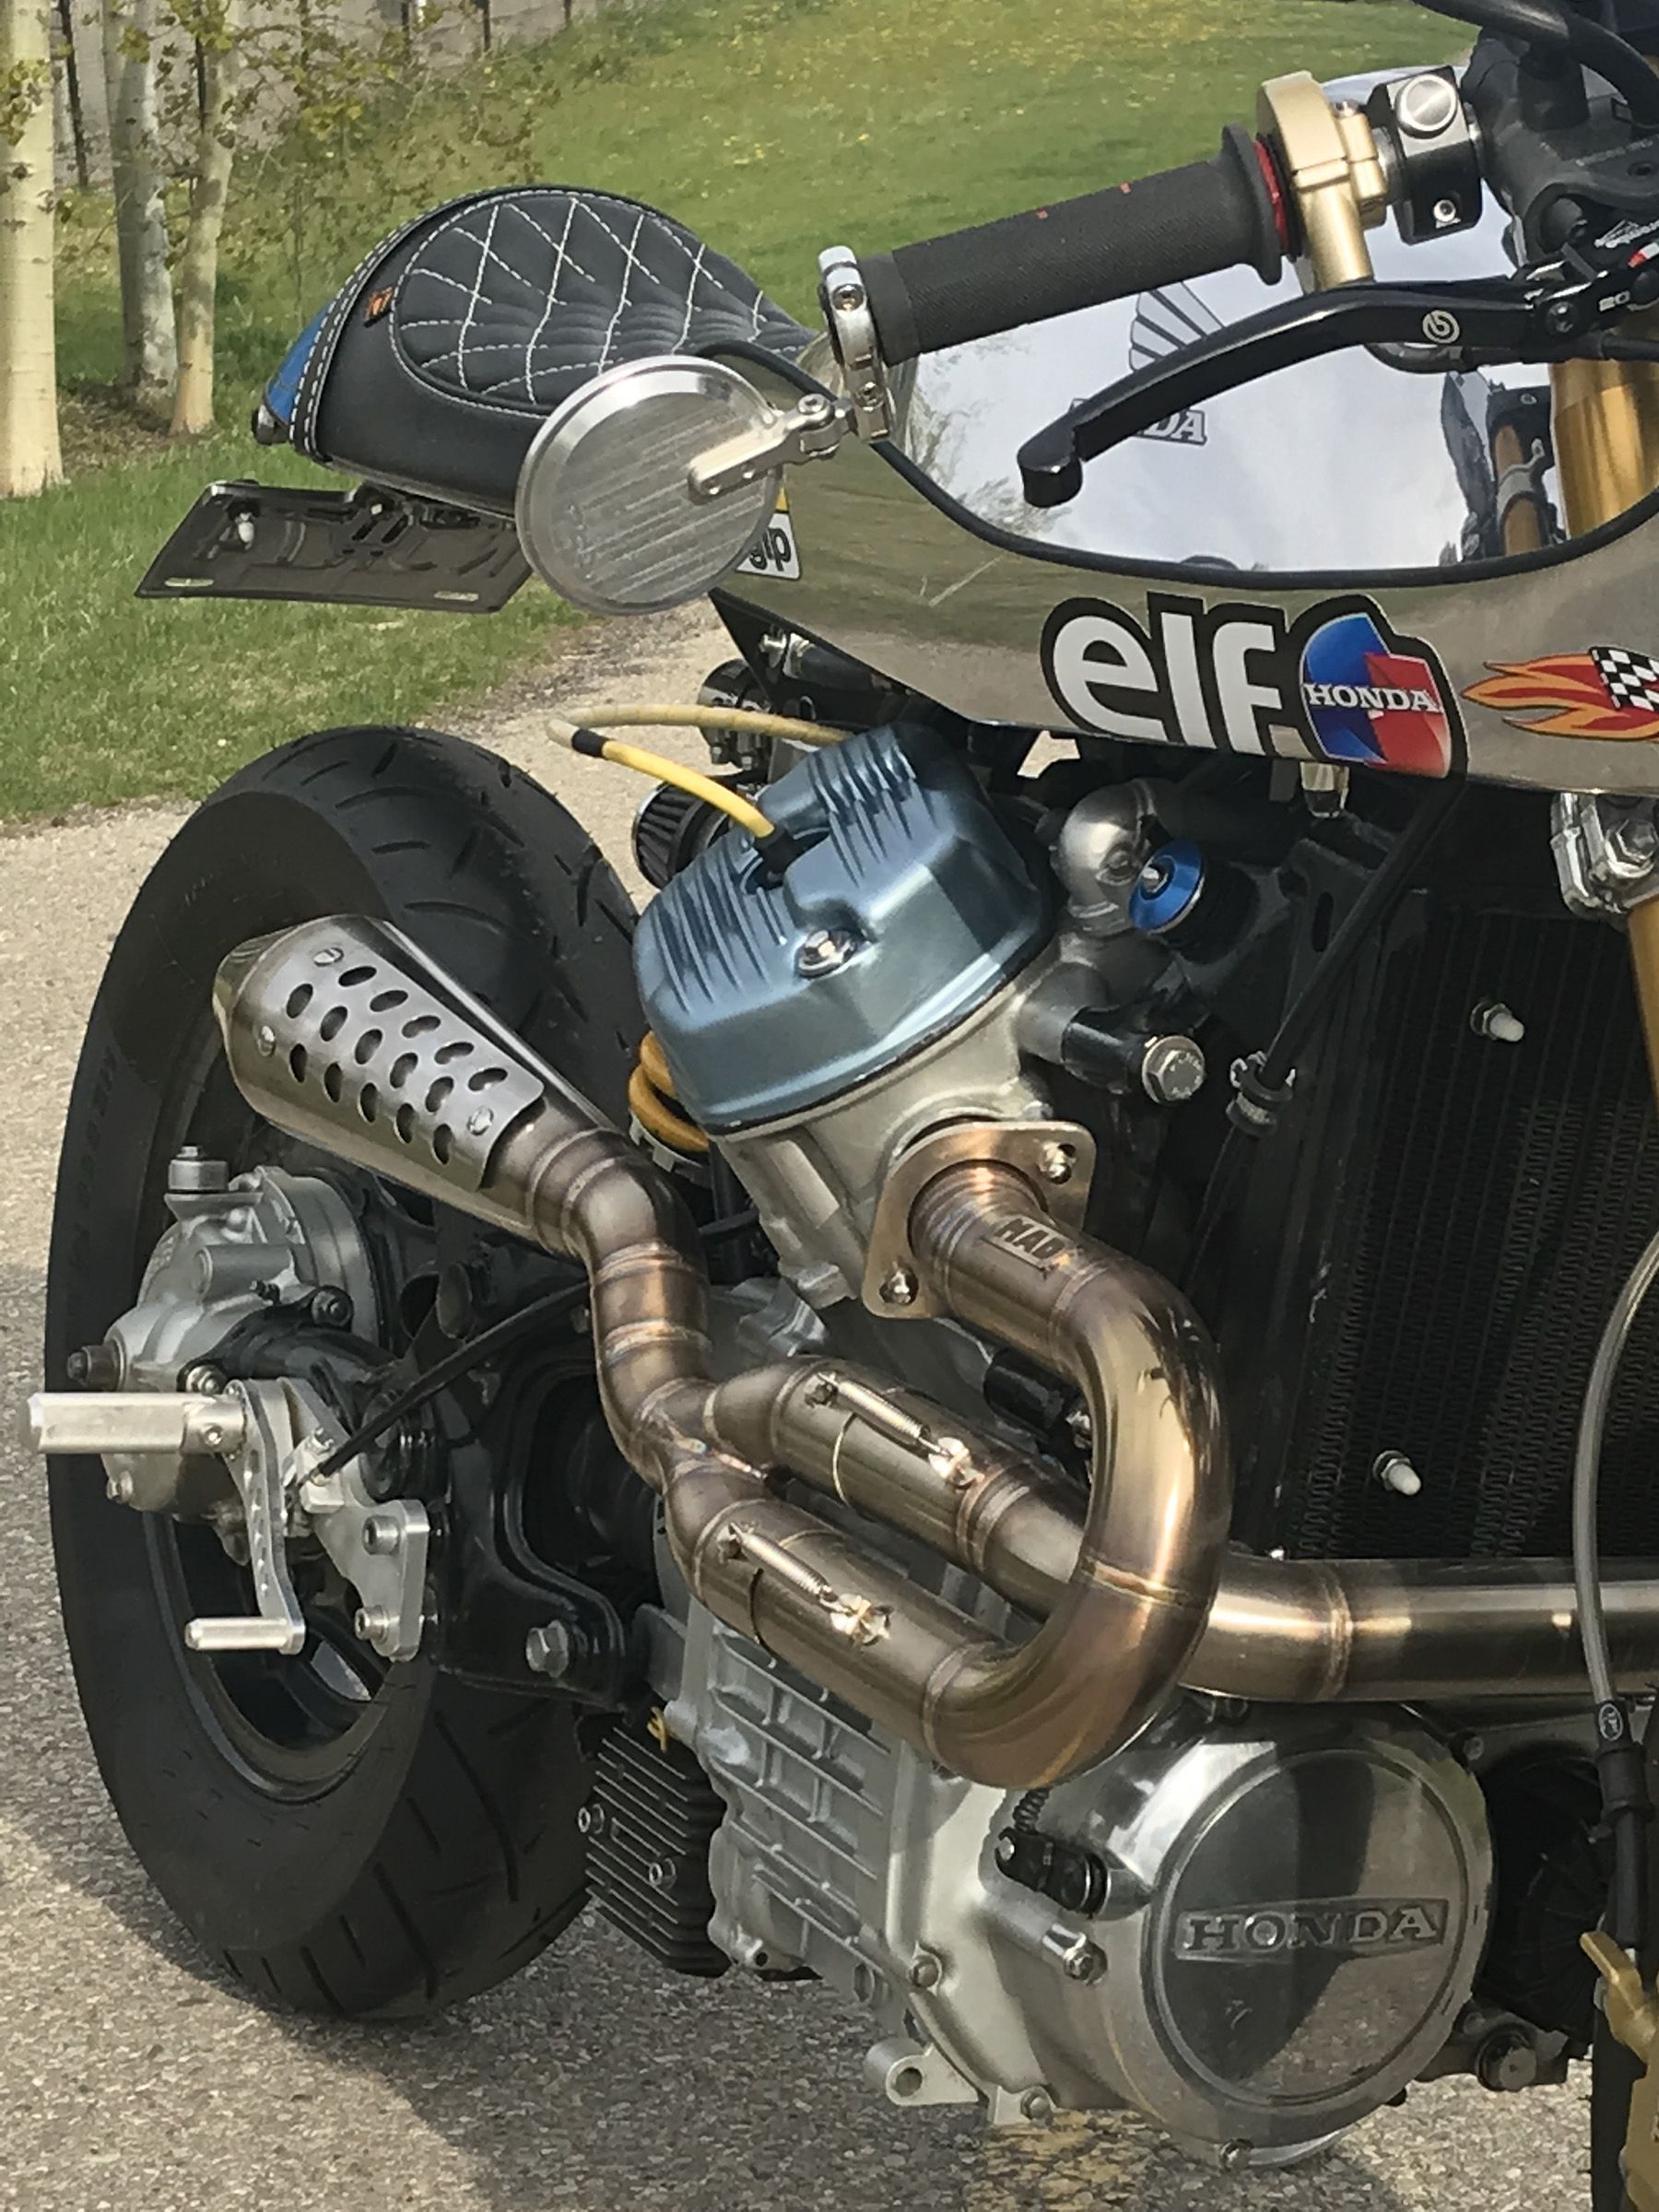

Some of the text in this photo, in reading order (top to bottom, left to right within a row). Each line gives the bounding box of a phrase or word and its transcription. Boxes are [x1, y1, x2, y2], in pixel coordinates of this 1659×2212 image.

[1053, 611, 1283, 755] elf
[1302, 683, 1443, 713] HONDA
[993, 1218, 1066, 1261] MAD
[1185, 1904, 1438, 1951] HONDA
